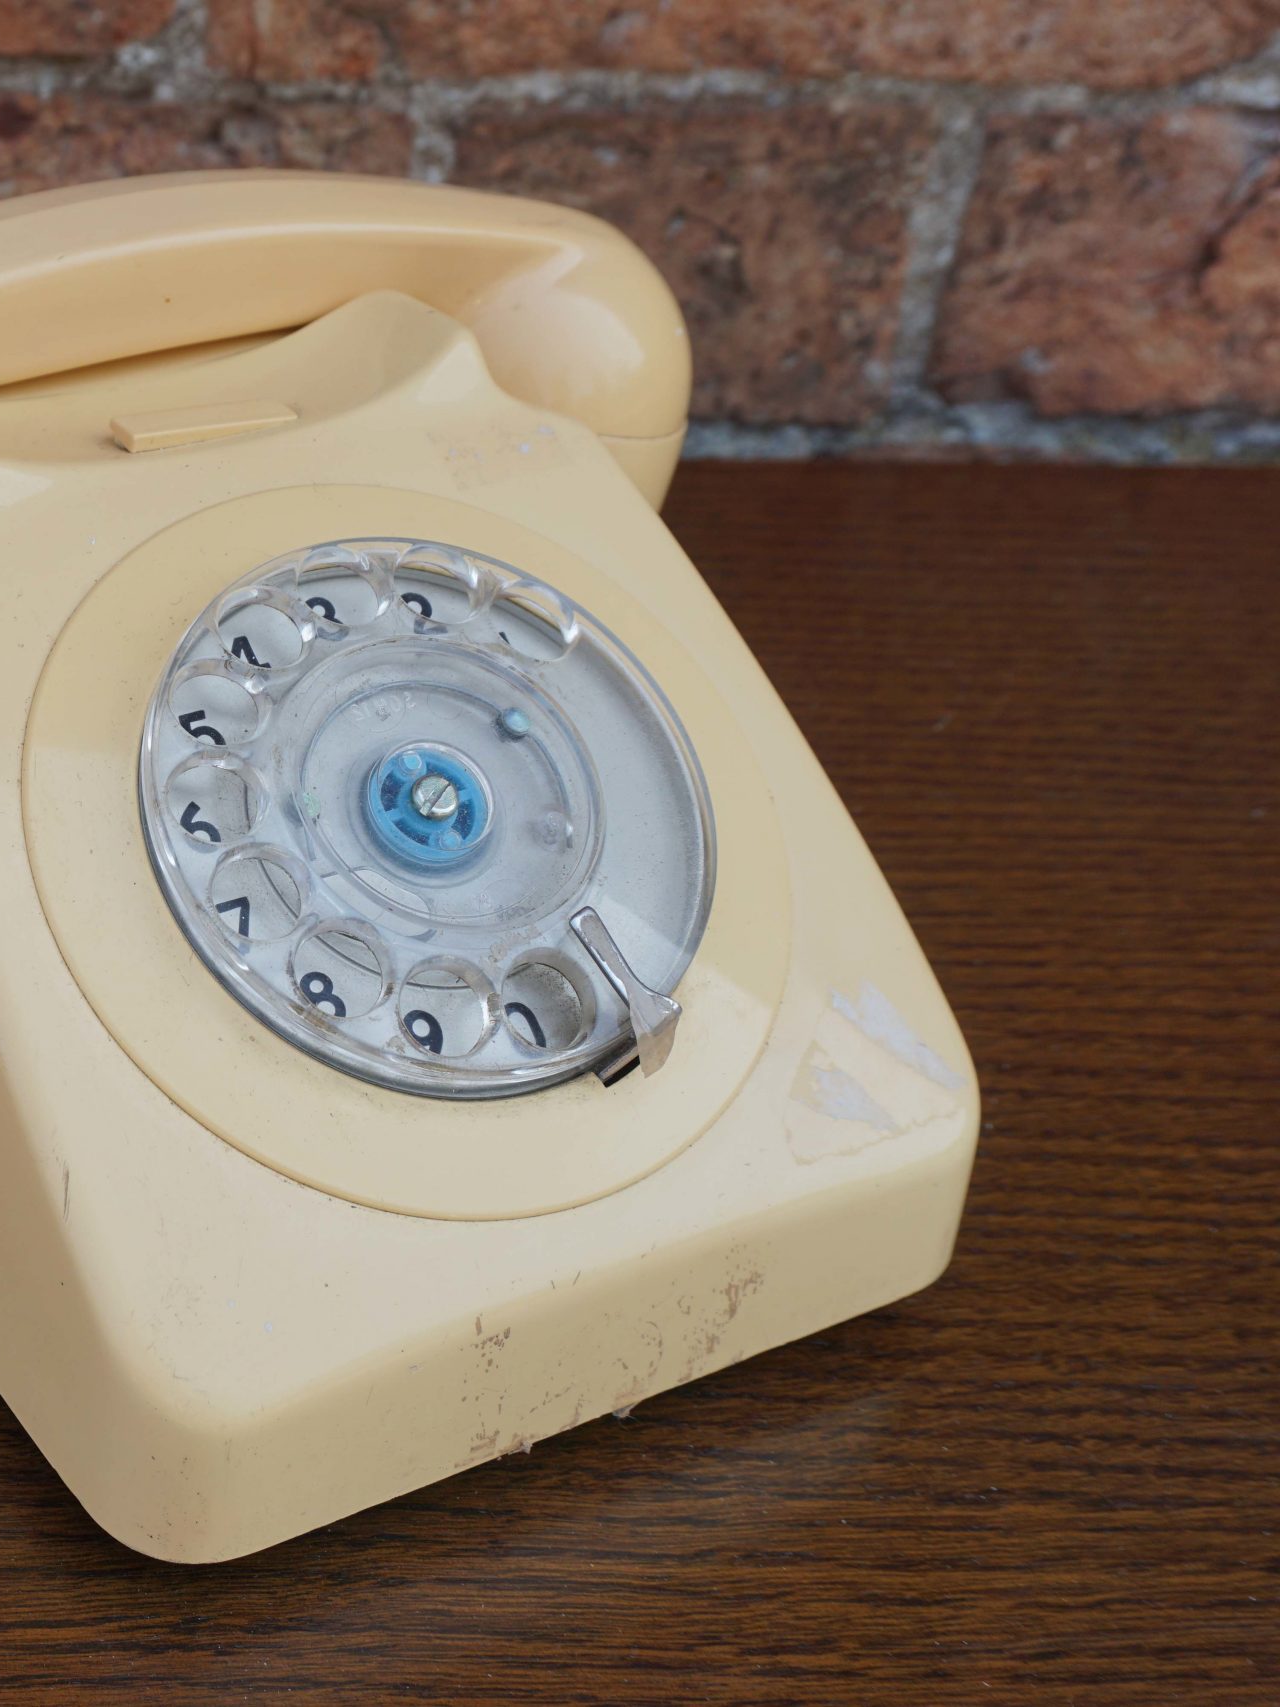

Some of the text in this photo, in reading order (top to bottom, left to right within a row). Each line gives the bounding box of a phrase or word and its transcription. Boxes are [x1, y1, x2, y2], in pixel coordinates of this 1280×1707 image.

[179, 709, 226, 746] 5
[180, 801, 221, 848] 6
[215, 896, 250, 946] 7
[300, 971, 346, 1018] 8
[404, 1009, 443, 1055] 9
